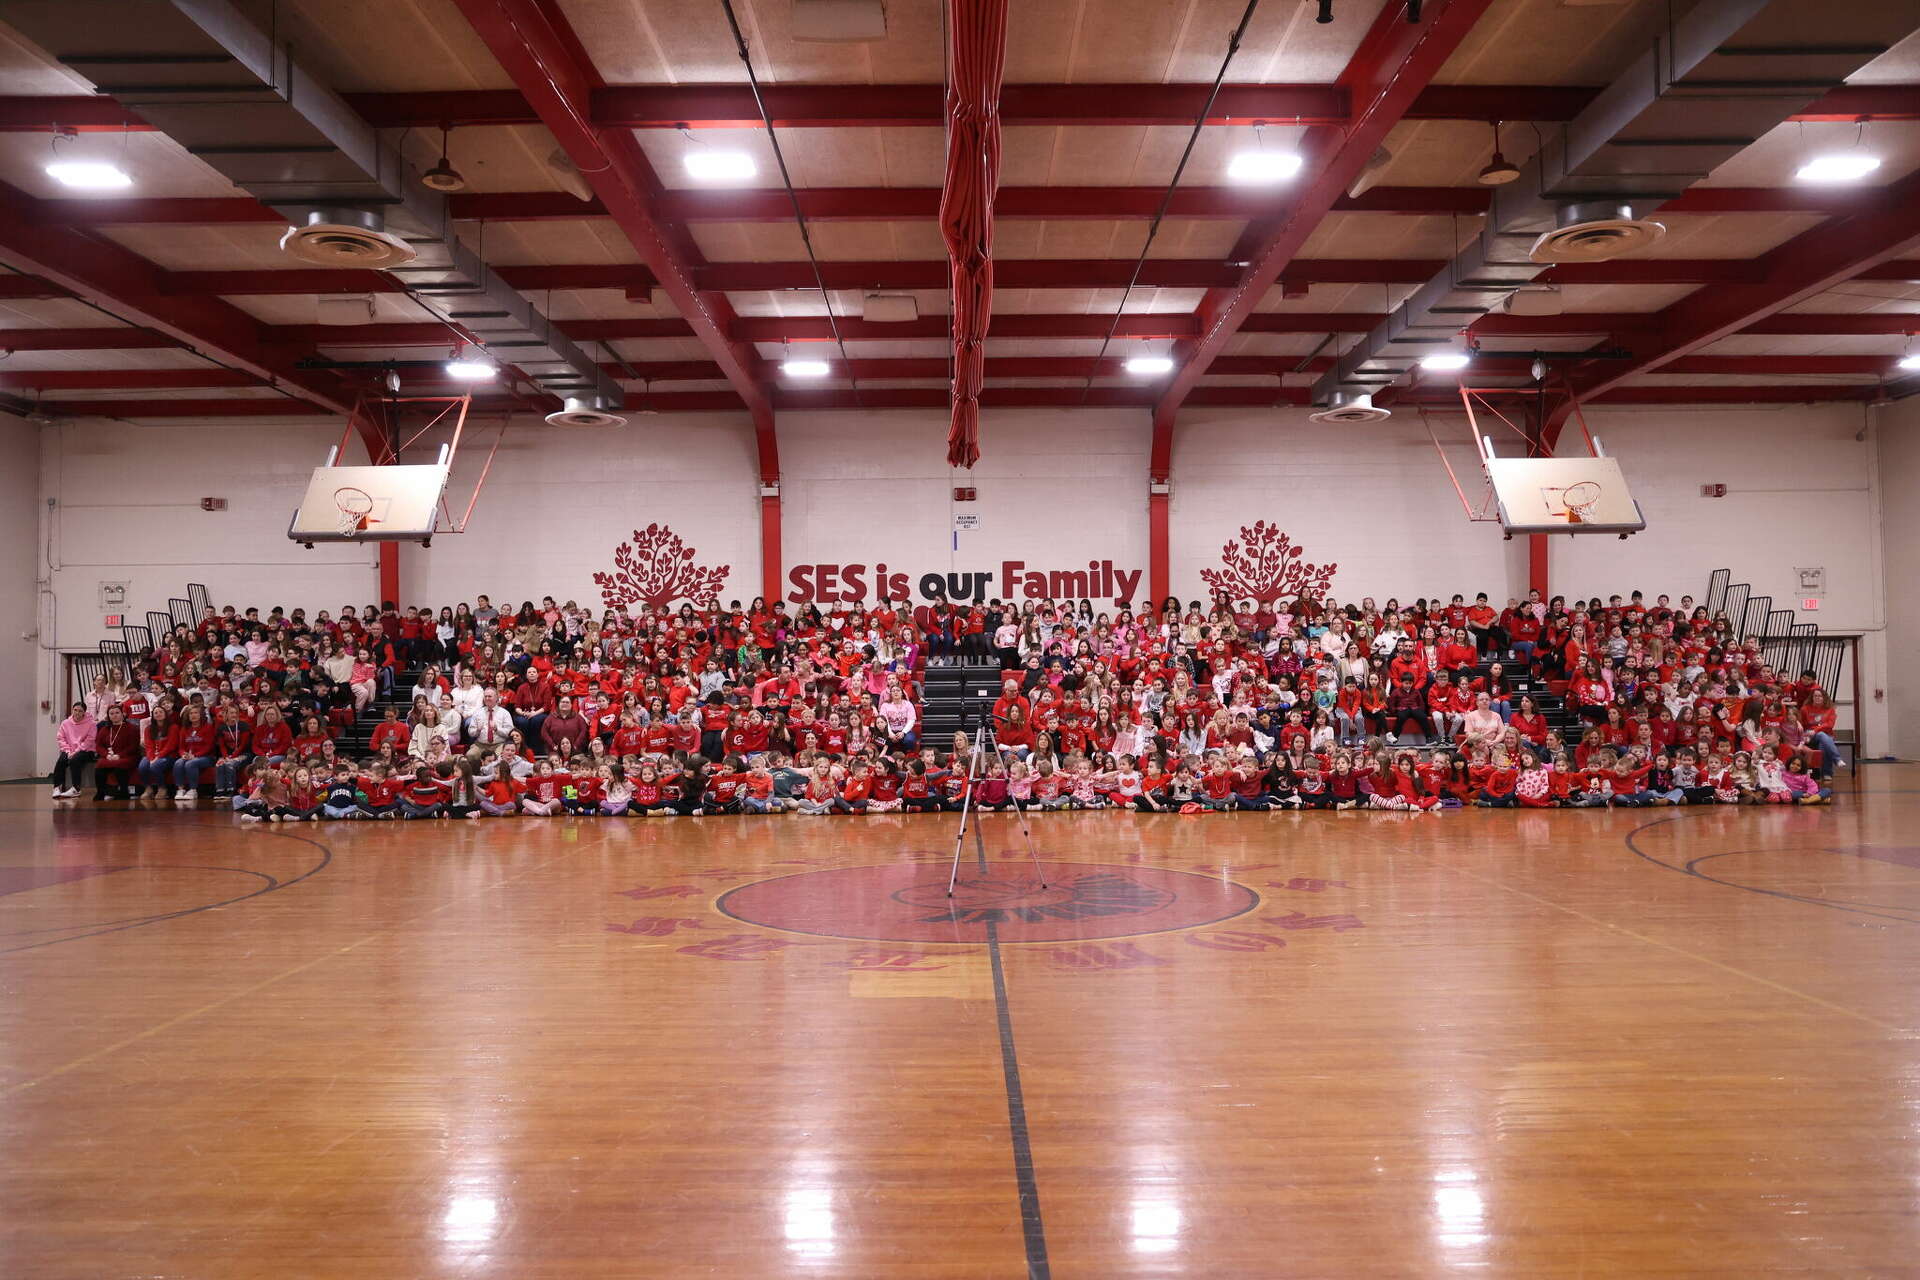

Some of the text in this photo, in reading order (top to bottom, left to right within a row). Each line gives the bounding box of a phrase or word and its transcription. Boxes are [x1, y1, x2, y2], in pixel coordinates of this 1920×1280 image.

[787, 560, 1143, 607] SES is our Family
